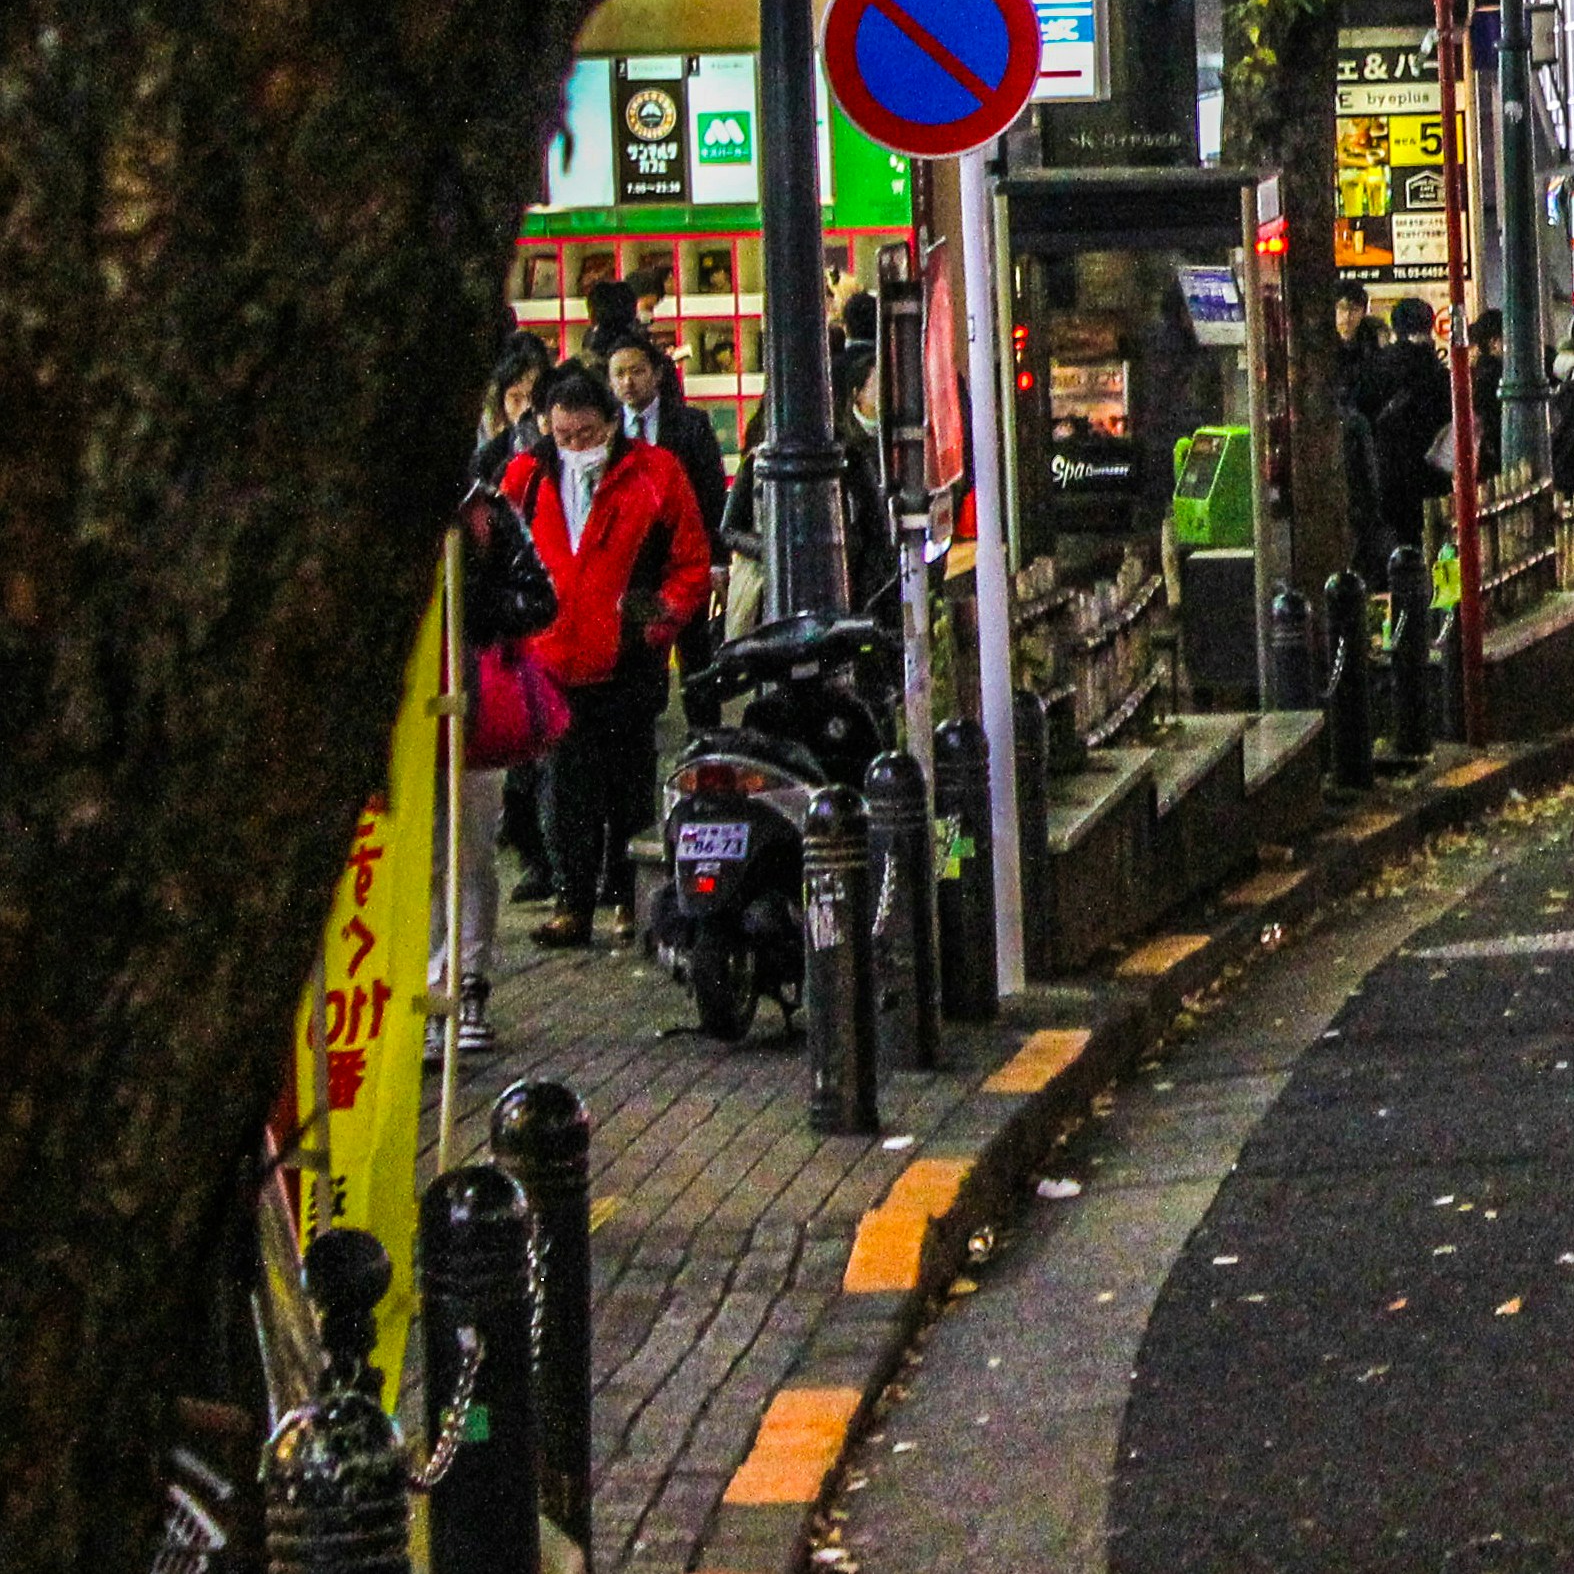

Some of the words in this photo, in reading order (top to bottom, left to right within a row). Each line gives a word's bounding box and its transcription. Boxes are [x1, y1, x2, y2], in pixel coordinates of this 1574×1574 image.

[1367, 91, 1386, 105] by
[1388, 90, 1430, 104] eplus
[626, 142, 678, 161] サンマルク
[701, 148, 749, 158] モスバーガー
[639, 160, 668, 174] カフェ
